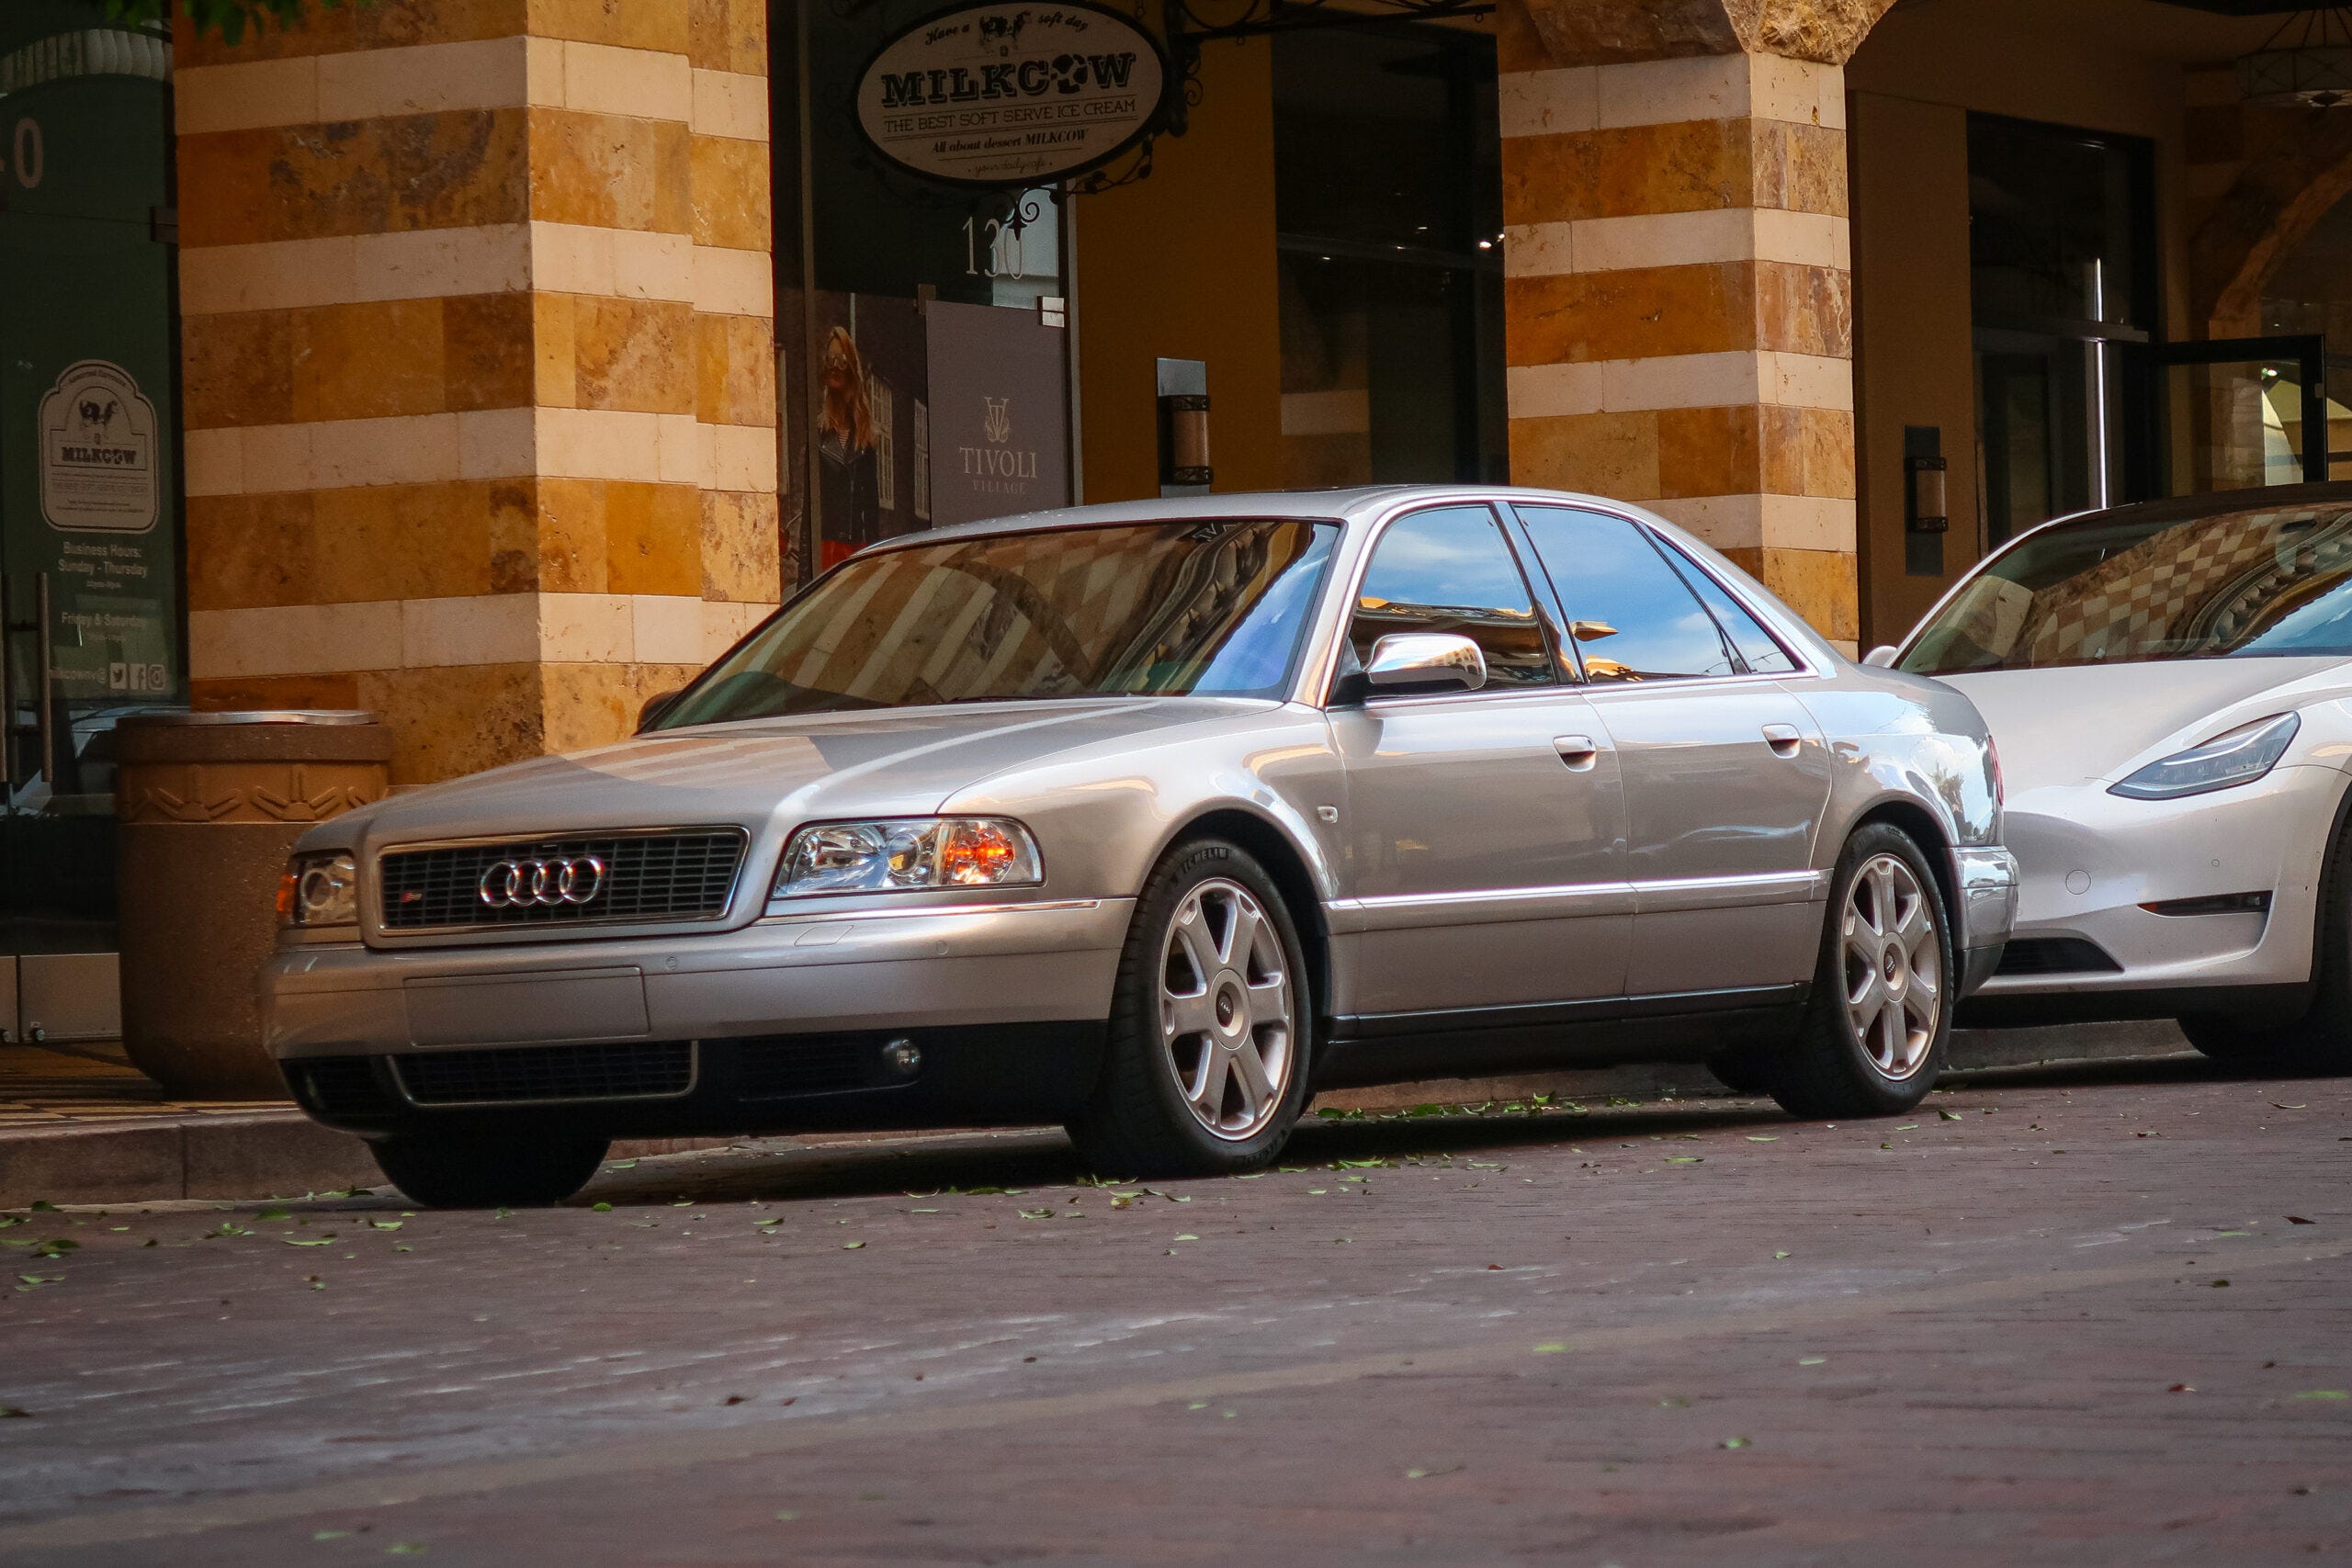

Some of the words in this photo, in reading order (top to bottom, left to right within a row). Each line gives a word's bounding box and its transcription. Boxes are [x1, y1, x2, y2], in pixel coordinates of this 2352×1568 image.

[925, 28, 958, 45] Have
[962, 24, 970, 33] a
[1038, 11, 1063, 28] soft
[1065, 15, 1089, 32] day
[880, 51, 1136, 107] MILKCOW
[884, 118, 914, 133] THE
[918, 116, 956, 130] BEST
[960, 111, 1000, 127] SOFT
[1003, 107, 1053, 123] SERVE
[1057, 105, 1080, 118] ICE
[1084, 99, 1136, 116] CREAM
[933, 141, 946, 152] All
[949, 140, 980, 152] about
[984, 137, 1021, 150] dessert
[1025, 129, 1089, 146] MILKCOW
[62, 446, 137, 465] MILKCOW
[959, 446, 1037, 479] TIVOLI
[972, 479, 1026, 495] VILLAGE
[62, 541, 107, 557] Business
[58, 558, 95, 576] Sunday
[104, 560, 147, 579] Thursday
[61, 611, 93, 628] Friday
[104, 613, 147, 628] Saturday
